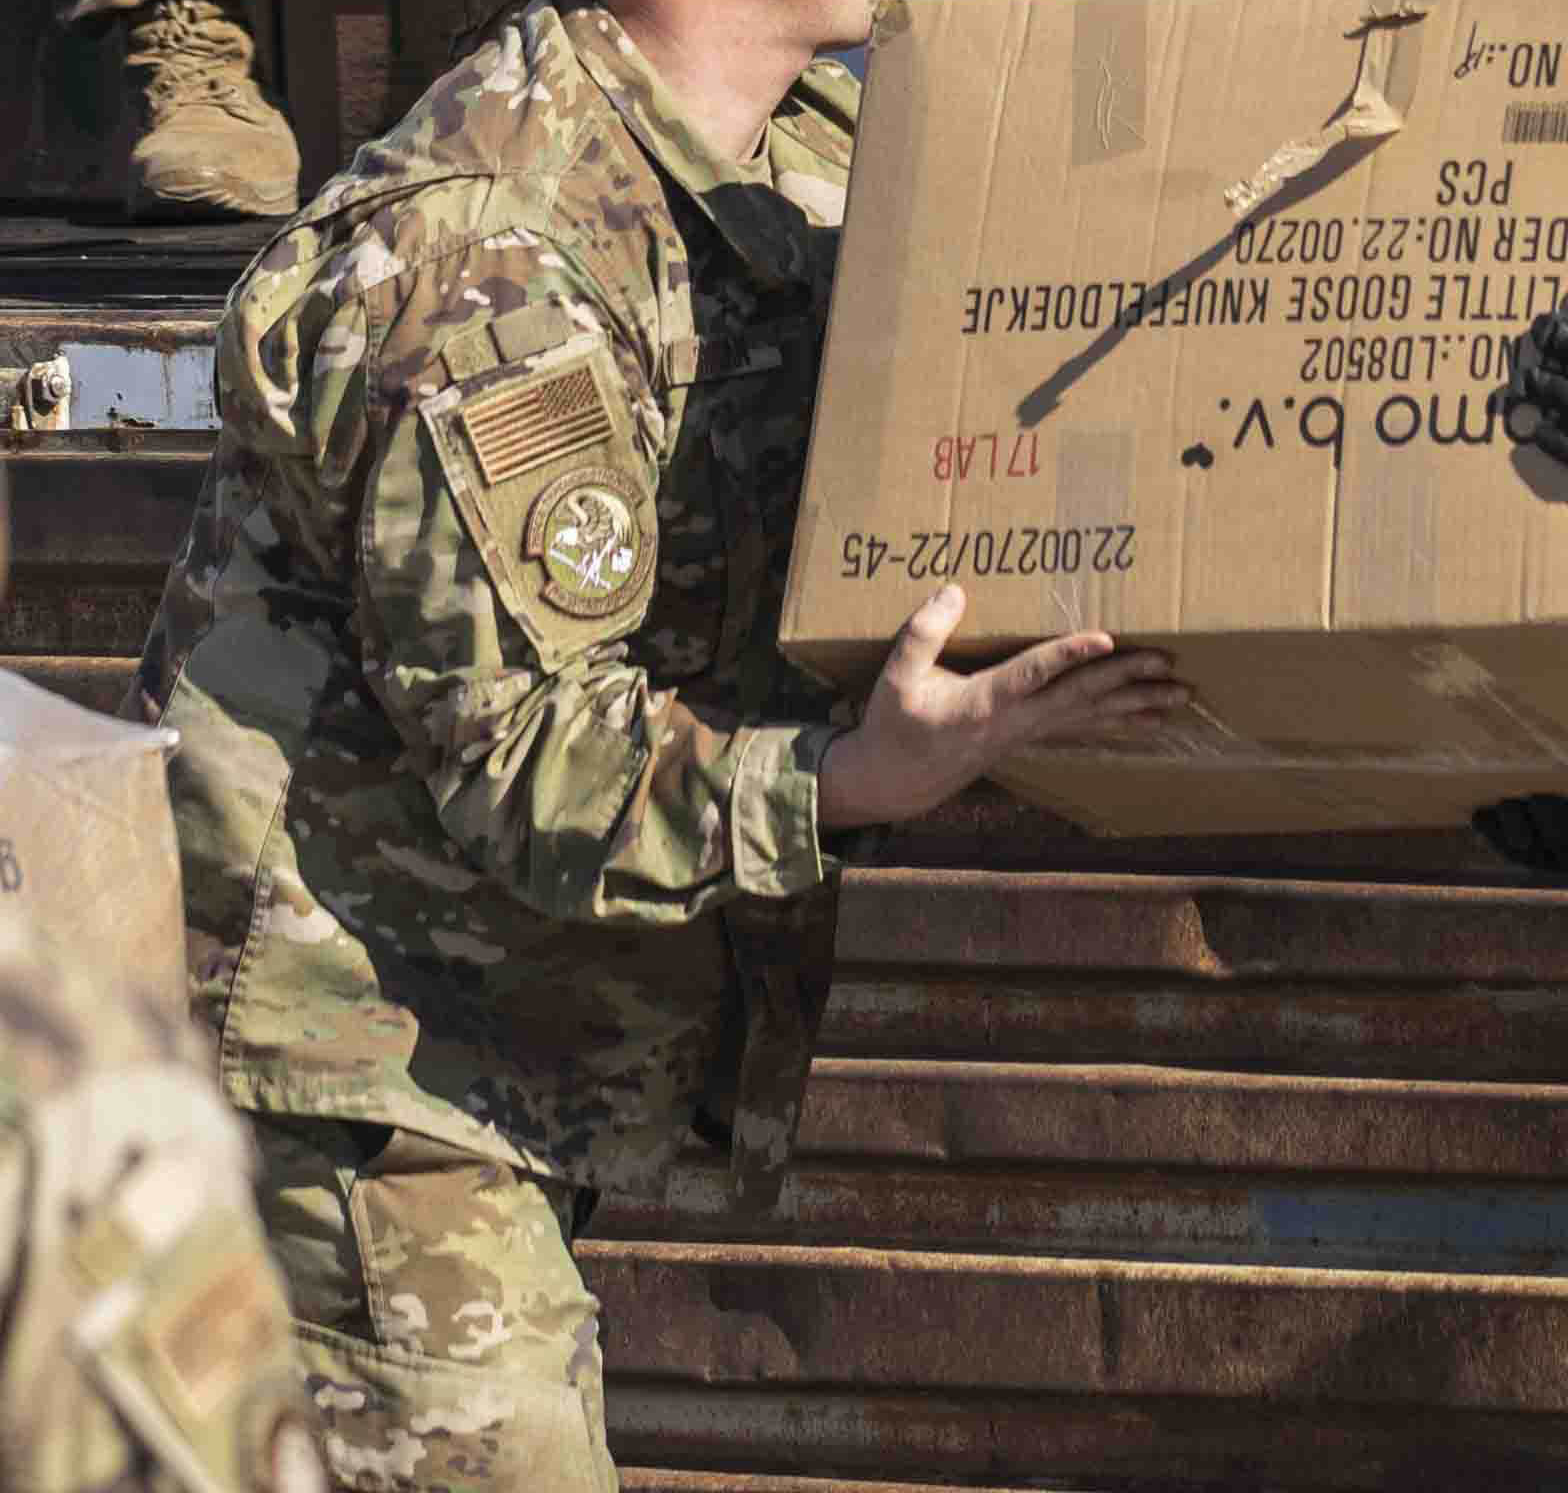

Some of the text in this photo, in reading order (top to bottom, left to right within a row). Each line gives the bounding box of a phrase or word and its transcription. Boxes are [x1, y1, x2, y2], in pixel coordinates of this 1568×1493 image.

[1436, 159, 1515, 208] PCS
[961, 273, 1562, 335] LITTLE GOOSE KNUFFELDOEKJE
[840, 524, 1138, 581] 22.00270/22-45
